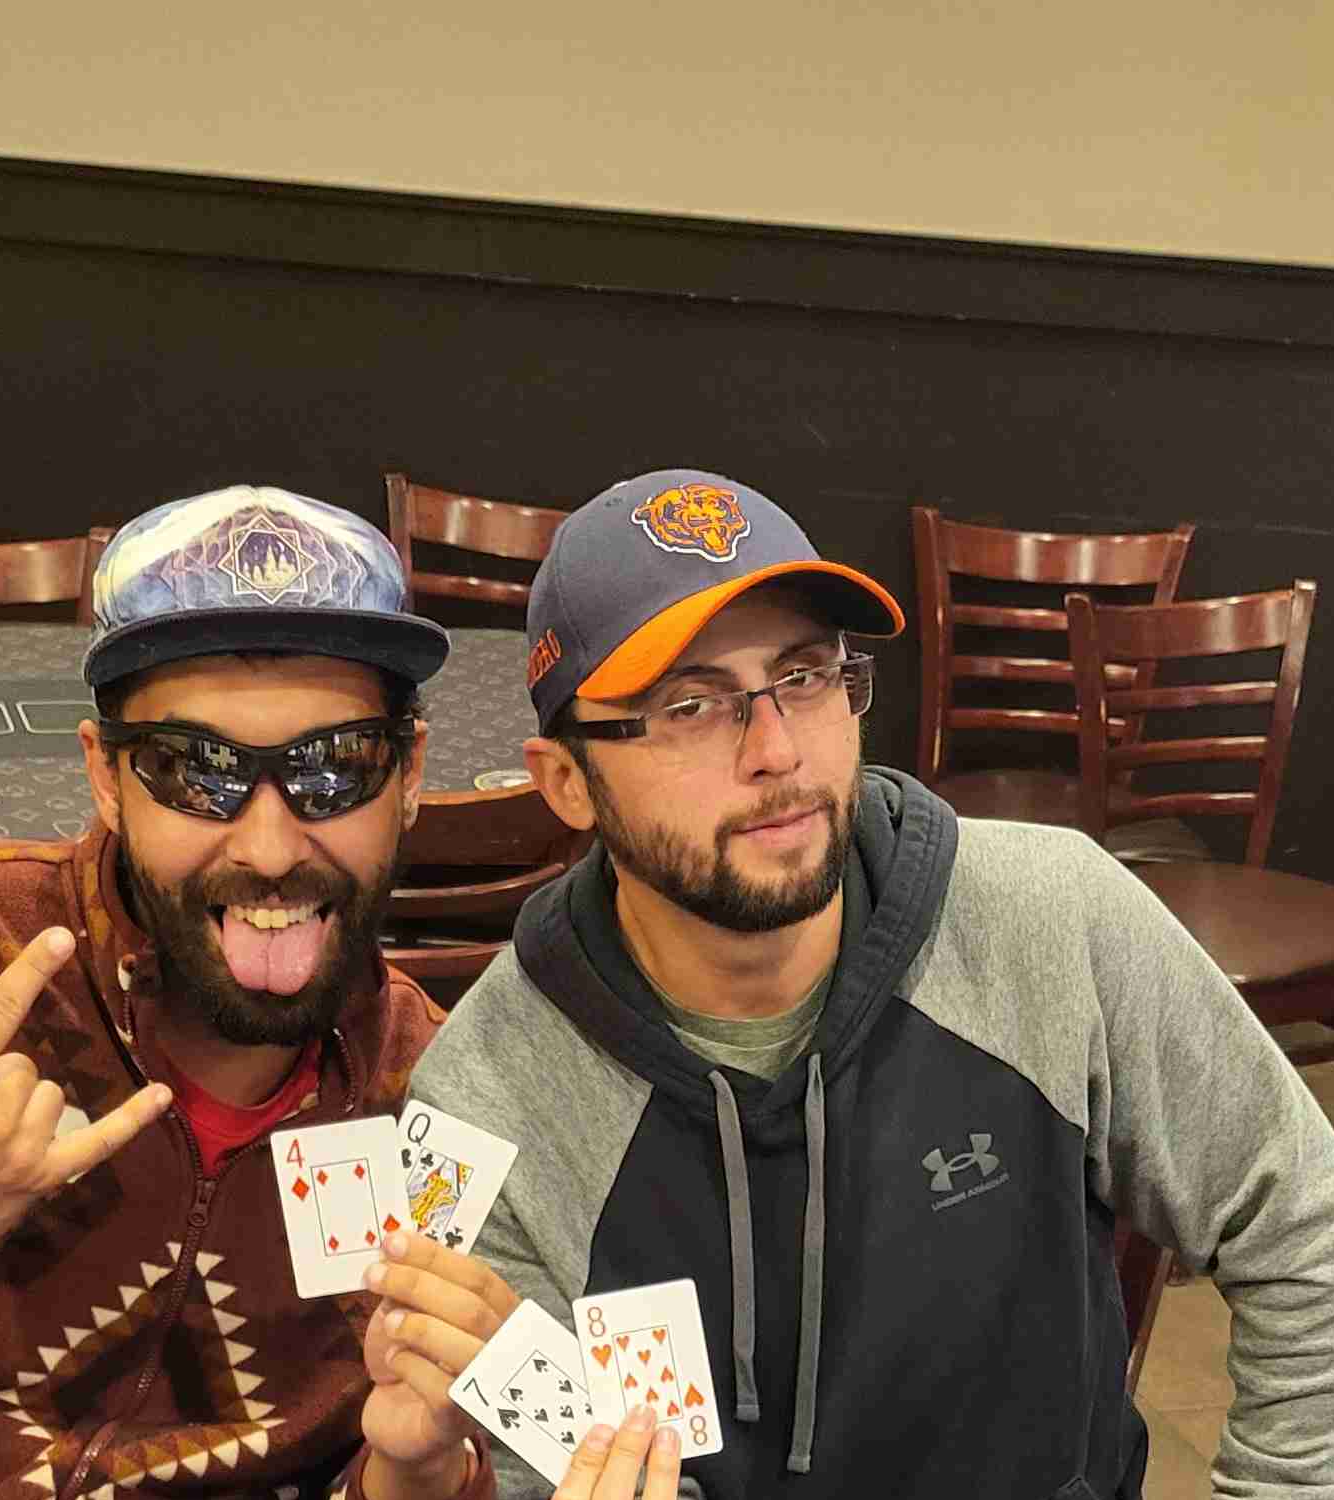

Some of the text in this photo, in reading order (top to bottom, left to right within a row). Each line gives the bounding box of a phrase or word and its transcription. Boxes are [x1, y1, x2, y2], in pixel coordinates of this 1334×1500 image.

[408, 1113, 431, 1146] Q
[286, 1139, 305, 1168] 4
[587, 1307, 607, 1337] 8
[463, 1378, 489, 1407] 7
[689, 1415, 708, 1446] 8
